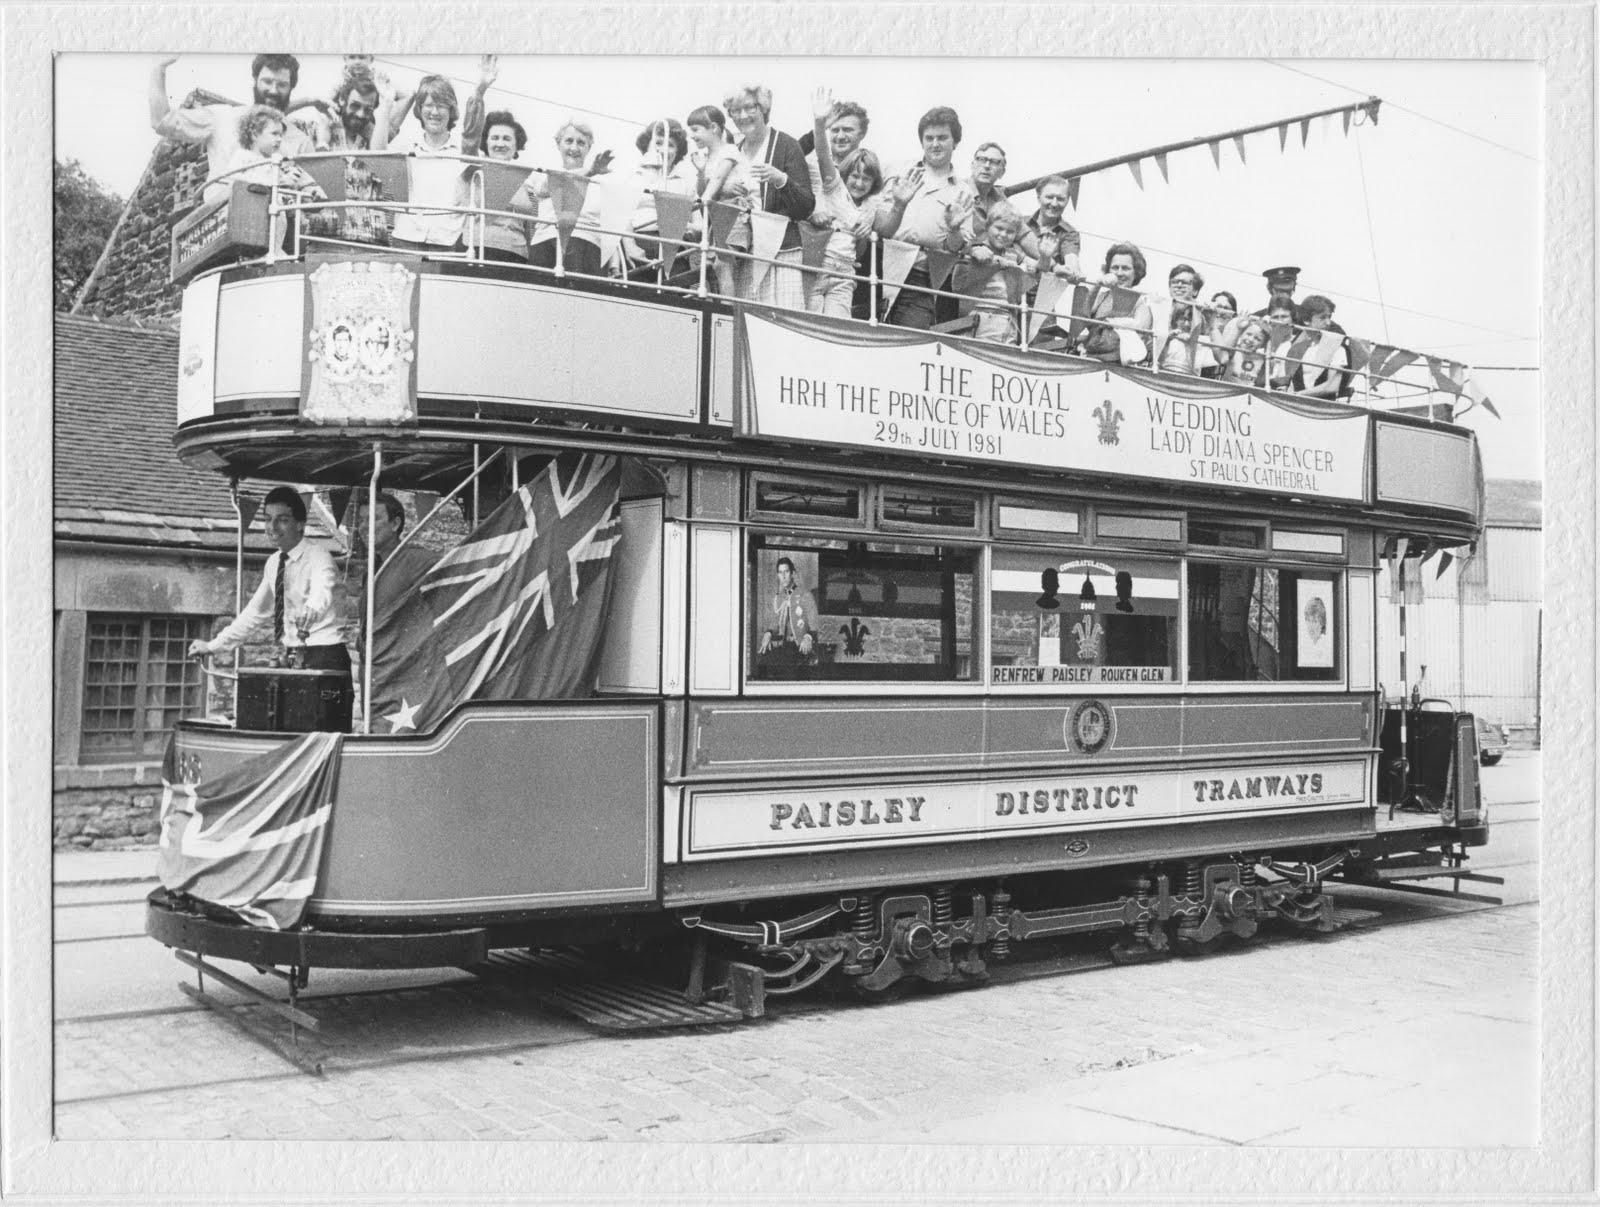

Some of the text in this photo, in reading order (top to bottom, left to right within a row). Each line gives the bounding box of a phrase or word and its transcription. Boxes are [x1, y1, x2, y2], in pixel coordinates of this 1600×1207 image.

[780, 376, 1066, 439] HRH THE PRINCE OF WALES
[921, 362, 1251, 437] THE ROYAL WEDDING
[874, 420, 1002, 455] 29th JULY 1981
[1151, 428, 1334, 473] LADY DIANA SPENCER
[1190, 459, 1320, 492] ST PAULS CATHEDRAL
[1059, 560, 1116, 575] CONGRATULATIONS
[993, 667, 1164, 683] RENFREW PAISLEY ROUKEN GLEN
[769, 772, 1324, 831] PAISLEY DISTRICT TRAMWAYS
